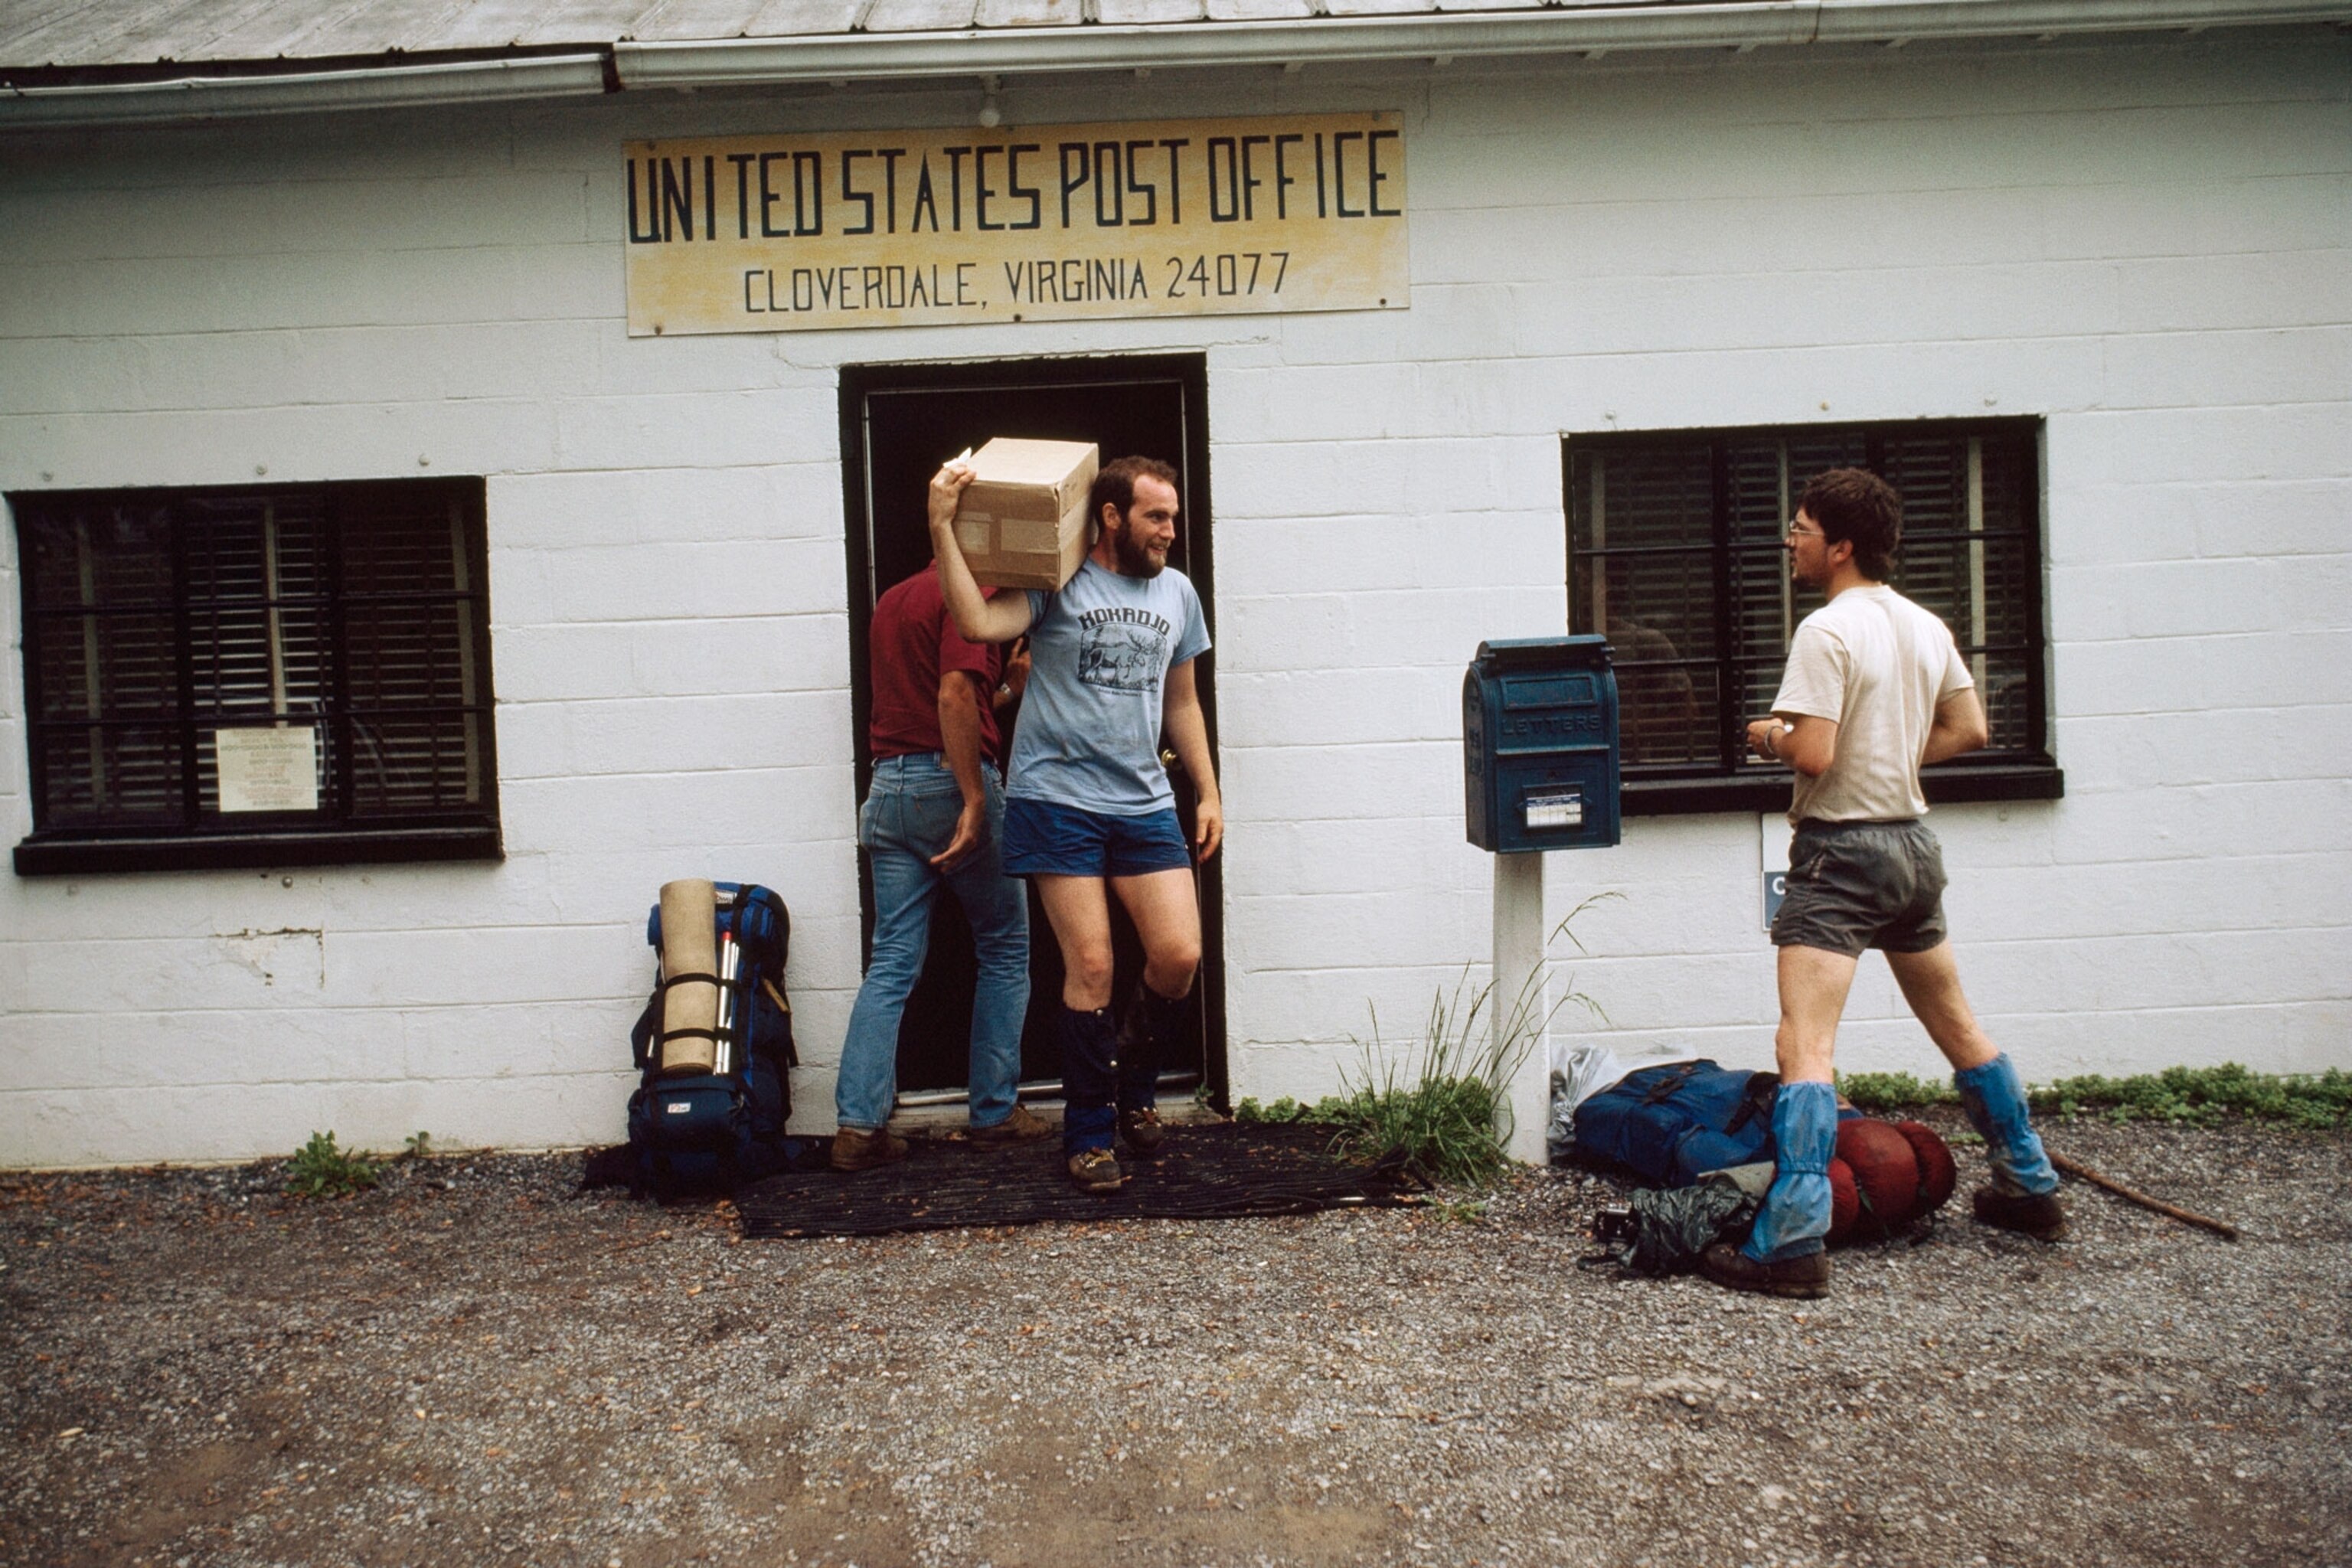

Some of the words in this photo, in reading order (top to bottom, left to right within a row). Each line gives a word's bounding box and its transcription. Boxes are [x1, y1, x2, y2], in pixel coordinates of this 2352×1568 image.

[627, 151, 823, 243] UNITED
[842, 144, 1040, 235] STATES
[1058, 139, 1190, 228] POST
[1207, 129, 1402, 223] OFFICE
[745, 263, 988, 313] CLOVERDALE,
[1004, 258, 1148, 304] VIRGINIA
[1166, 252, 1290, 299] 24077
[1078, 607, 1171, 636] KOKADJO
[1501, 714, 1601, 736] LETTERS
